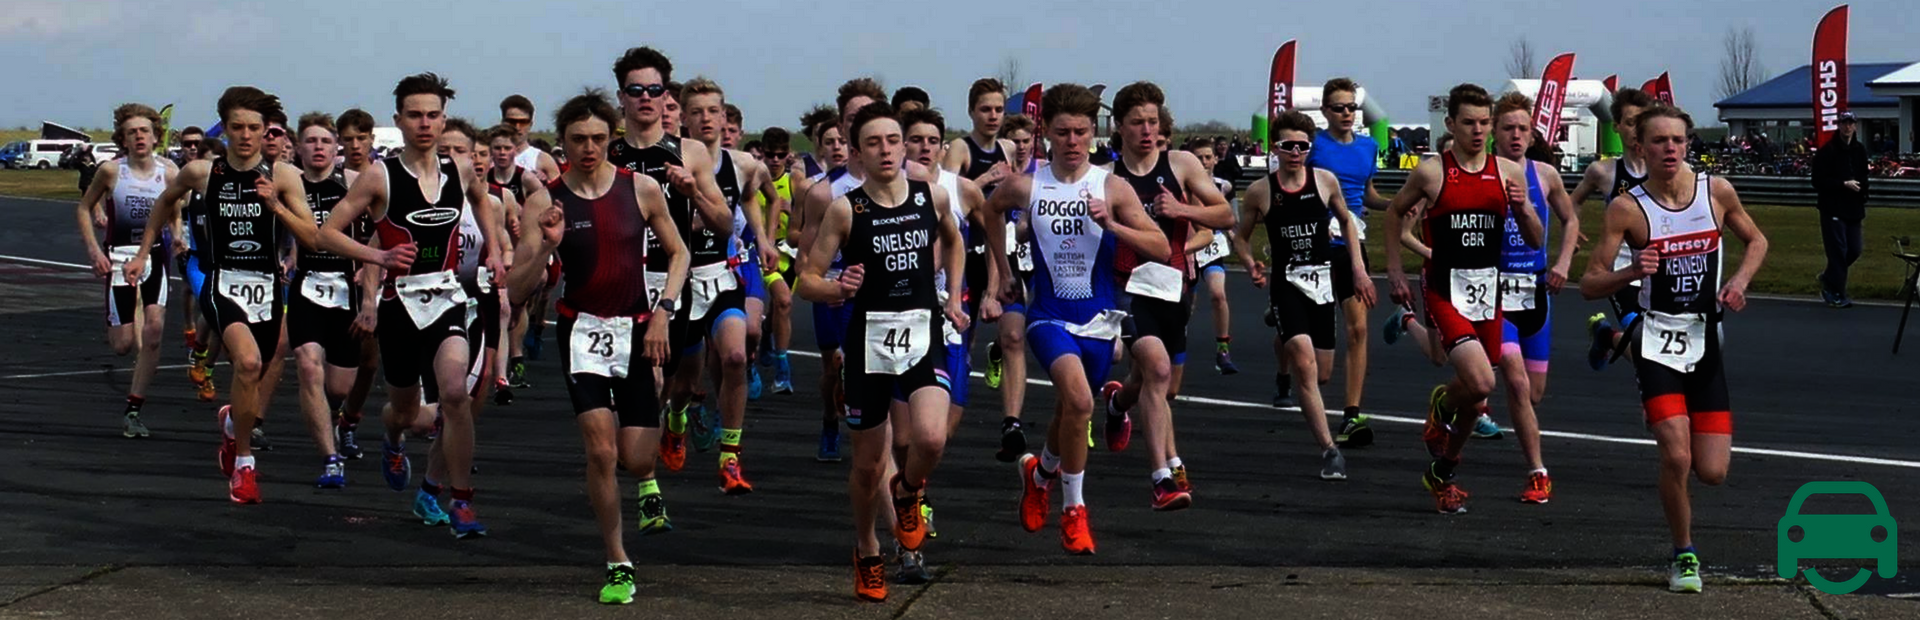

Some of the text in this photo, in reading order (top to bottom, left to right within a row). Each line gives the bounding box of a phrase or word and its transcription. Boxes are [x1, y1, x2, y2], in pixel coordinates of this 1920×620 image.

[1273, 82, 1287, 118] GH5
[1819, 60, 1839, 132] HIGH5
[218, 202, 262, 218] HOWARD
[1037, 199, 1089, 217] BOGGO
[229, 220, 255, 236] GBR
[1051, 218, 1085, 236] GBR
[1280, 221, 1318, 239] REILLY
[1450, 213, 1496, 230] MARTIN
[872, 229, 929, 254] SNELSON
[1290, 238, 1313, 250] GBR
[1461, 231, 1485, 247] GBR
[1508, 234, 1525, 247] GB
[1661, 237, 1711, 254] Jersey
[1204, 242, 1219, 256] 43
[884, 251, 920, 272] GBR
[1665, 253, 1709, 276] KENNEDY
[315, 285, 334, 300] 51
[1501, 279, 1519, 295] 41
[1670, 274, 1705, 294] JEY
[1466, 283, 1487, 304] 32
[588, 331, 614, 357] 23
[883, 327, 911, 354] 44
[1659, 330, 1687, 355] 25
